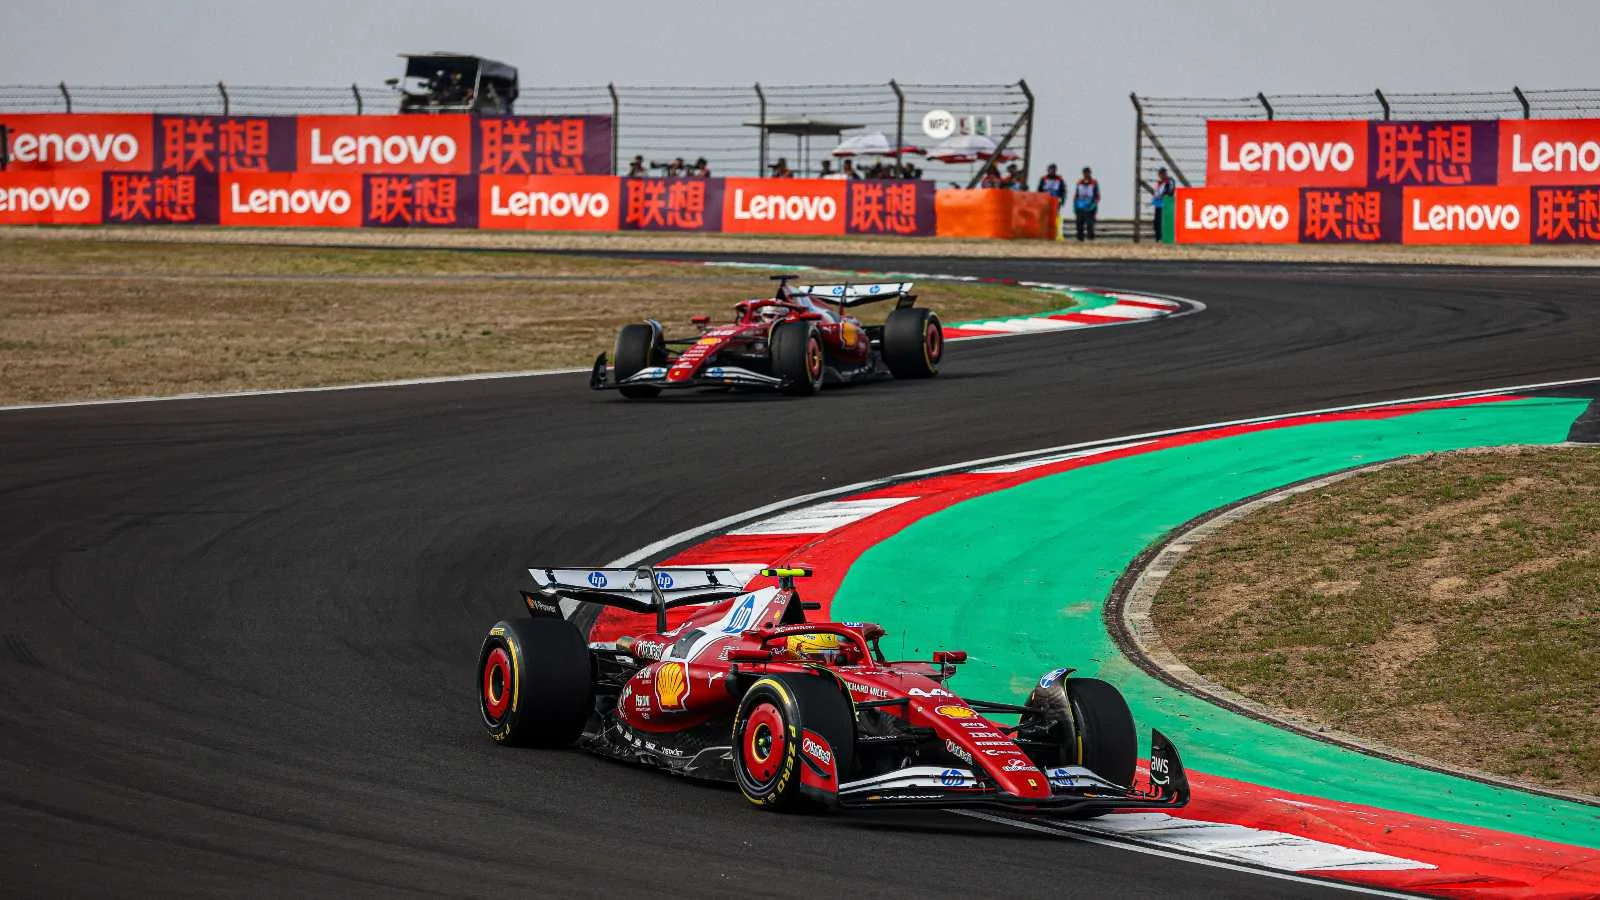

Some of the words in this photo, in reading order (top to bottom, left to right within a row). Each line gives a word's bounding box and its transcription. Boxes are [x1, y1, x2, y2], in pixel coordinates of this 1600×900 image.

[929, 118, 950, 130] MP2
[9, 133, 138, 162] enovo
[161, 118, 271, 172] 联想
[311, 129, 456, 165] Lenovo
[479, 118, 586, 175] 联想
[1219, 134, 1355, 172] Lenovo
[1375, 124, 1472, 184] 联想
[1512, 133, 1600, 173] Leno
[109, 174, 195, 222] 联想
[231, 182, 351, 214] Lenovo
[368, 176, 457, 224] 联想
[491, 185, 610, 217] Lenovo
[625, 179, 705, 228] 联想
[734, 188, 836, 222] Lenovo
[850, 183, 917, 234] 联想
[1184, 198, 1289, 231] Lenovo
[1304, 190, 1381, 240] 联想
[1412, 198, 1521, 231] Lenovo
[590, 572, 606, 588] hp
[657, 572, 672, 588] hp
[870, 686, 889, 698] MILLE
[788, 724, 796, 738] P
[777, 741, 797, 793] ZERO
[1151, 755, 1169, 774] aws
